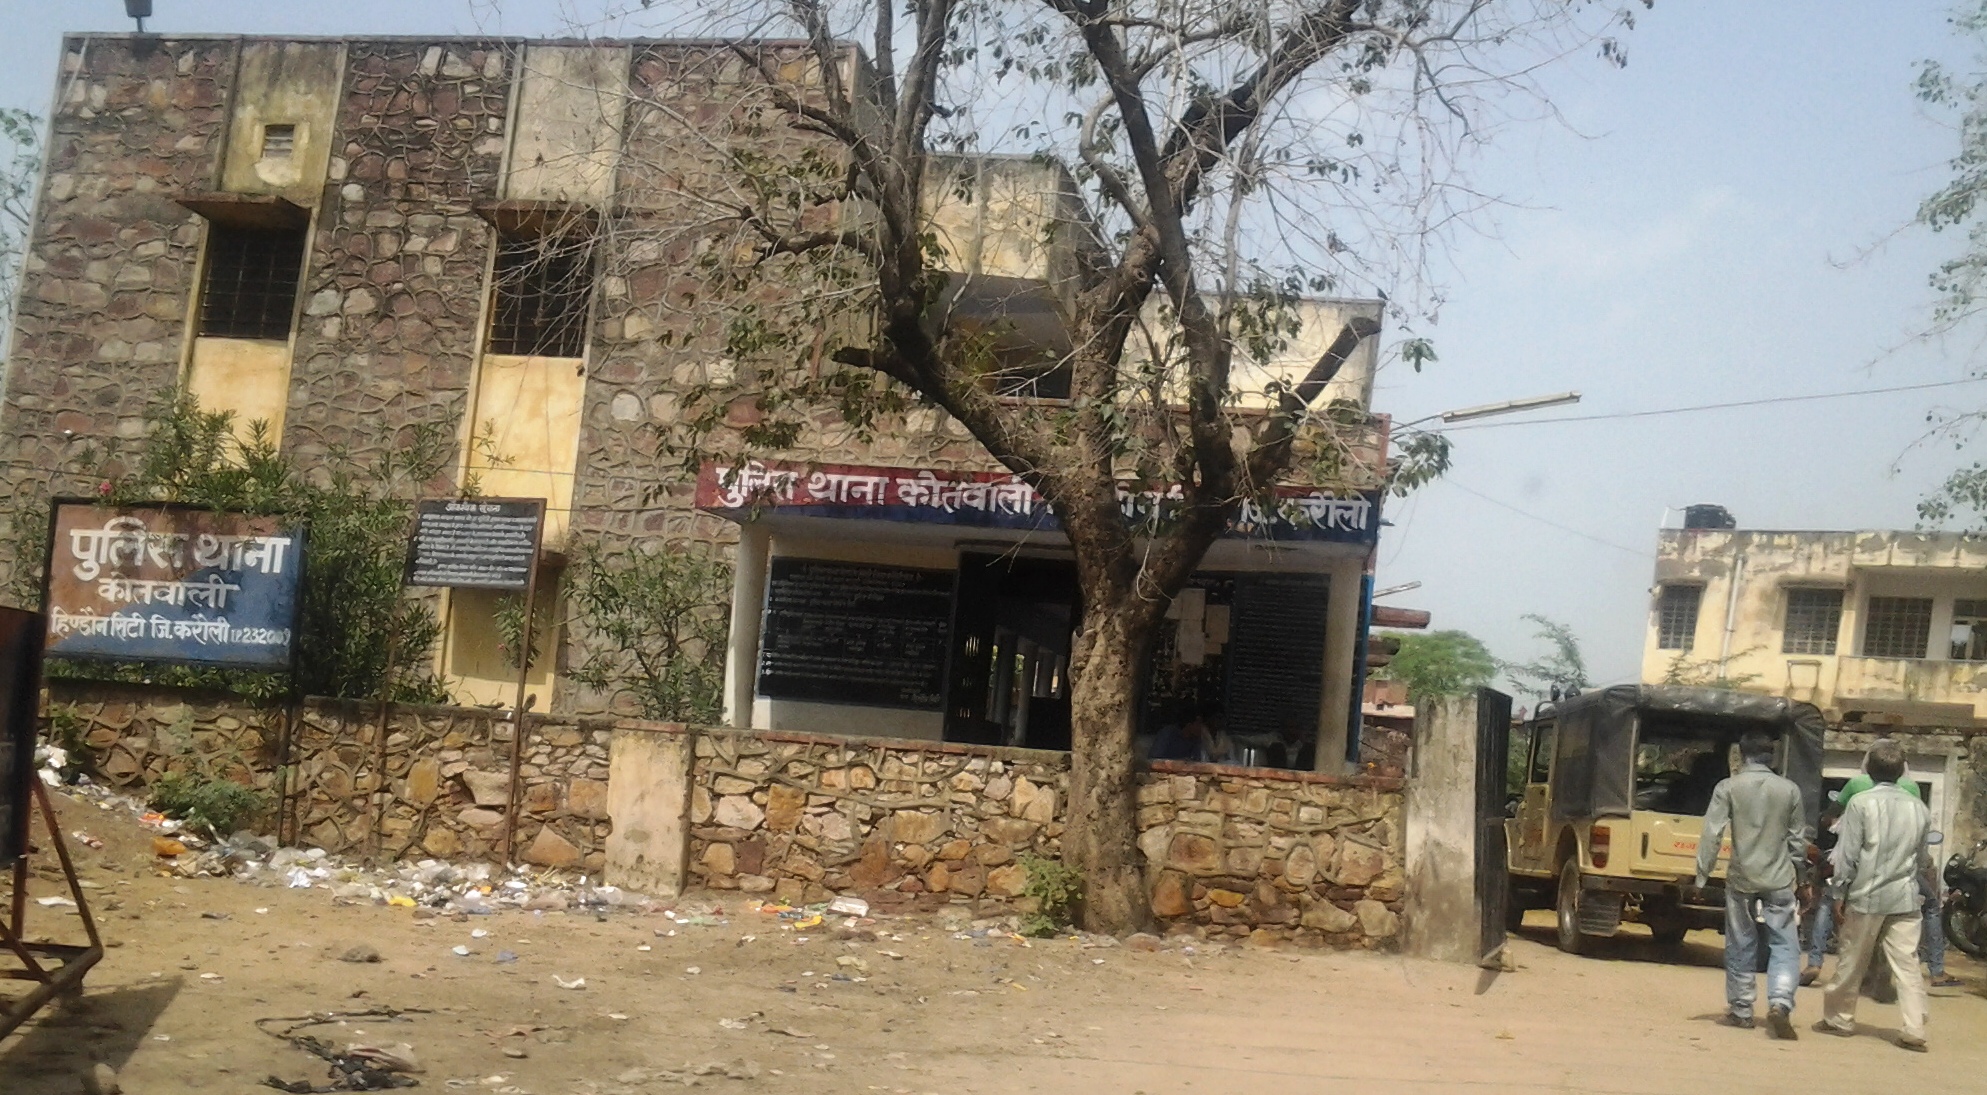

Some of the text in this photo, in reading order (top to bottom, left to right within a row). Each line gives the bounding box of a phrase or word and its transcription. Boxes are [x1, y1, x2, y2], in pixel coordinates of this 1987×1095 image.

[716, 461, 798, 507] पुलिस
[808, 472, 890, 505] थाना
[896, 470, 1034, 514] कोतवाली
[70, 516, 291, 581] पुलिस थाना
[98, 571, 241, 608] कोतवाली
[110, 611, 147, 641] सिटी
